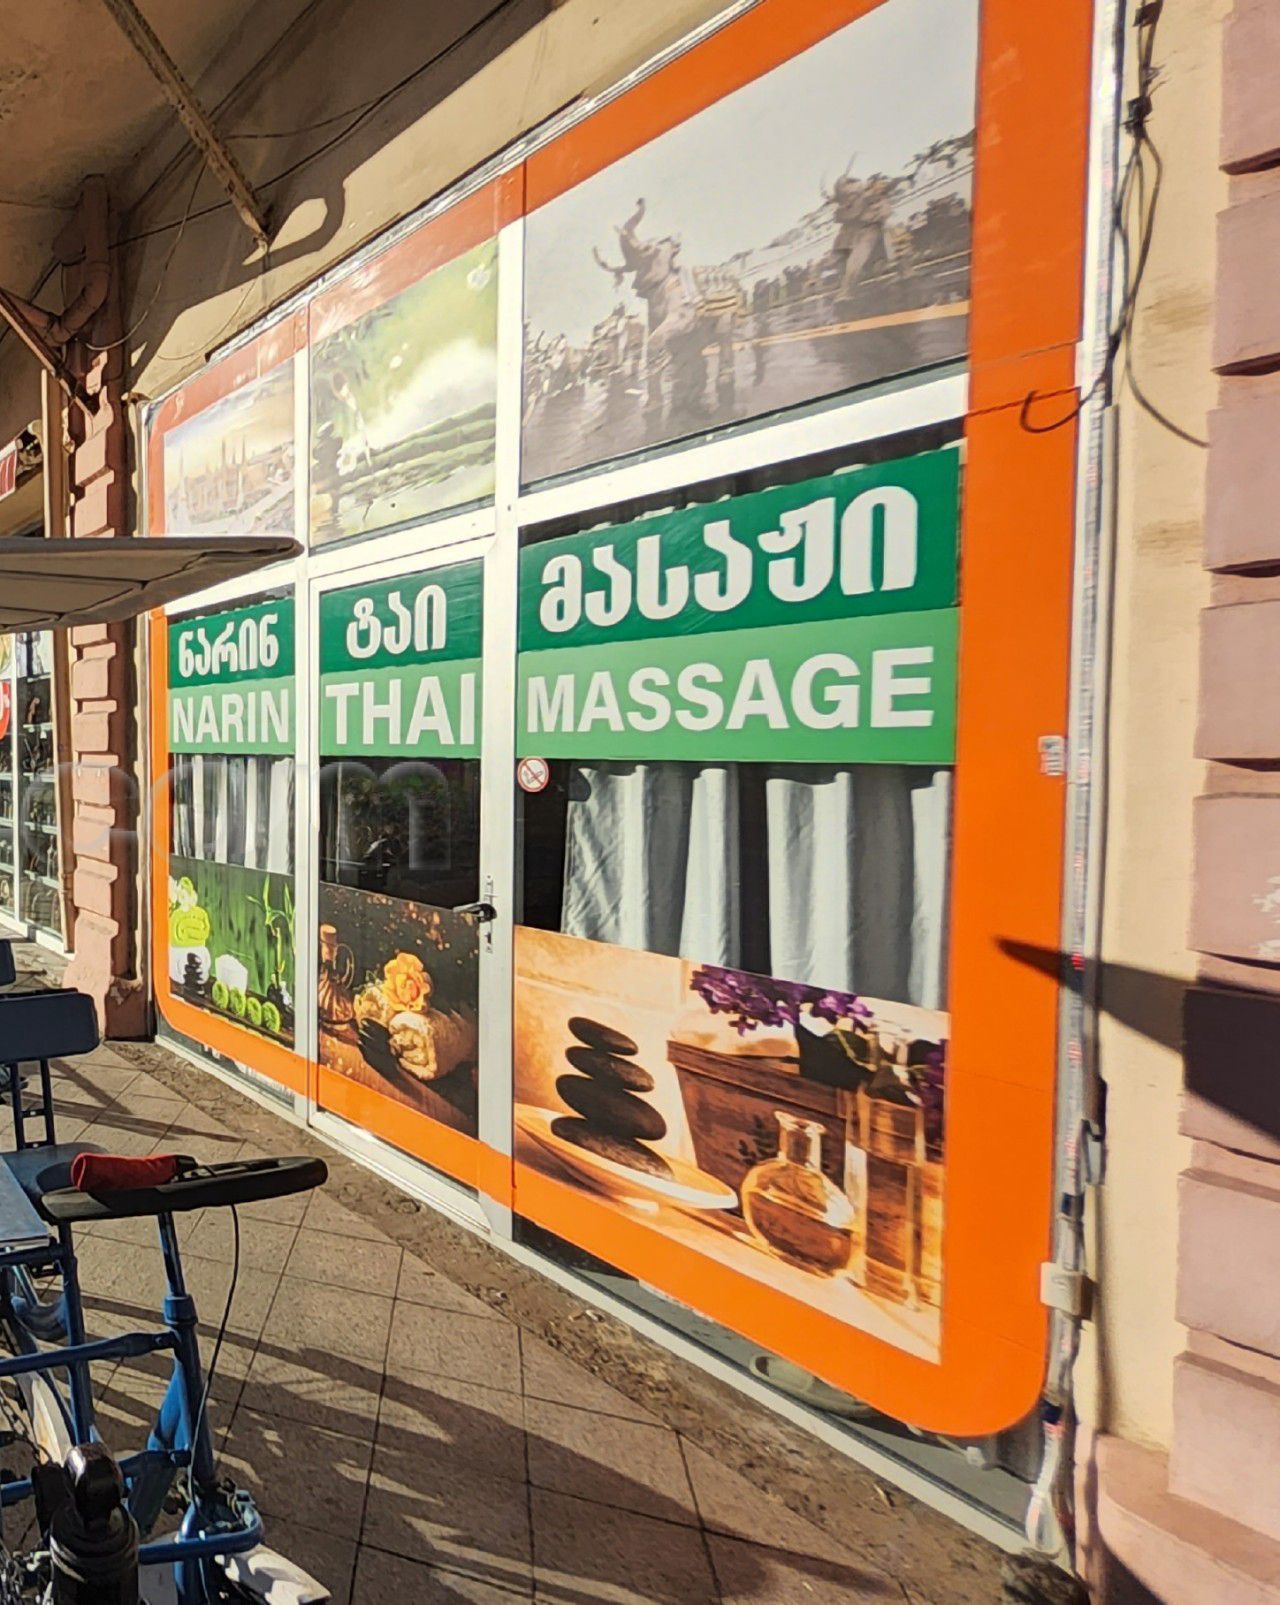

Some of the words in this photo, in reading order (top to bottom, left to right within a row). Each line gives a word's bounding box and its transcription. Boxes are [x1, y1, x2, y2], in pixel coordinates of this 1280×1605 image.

[177, 612, 279, 678] ნარინ
[345, 584, 447, 659] ტაი
[539, 486, 918, 633] მასაჟი
[172, 688, 290, 744] NARIN
[324, 672, 477, 746] THAI
[525, 646, 935, 734] MASSAGE
